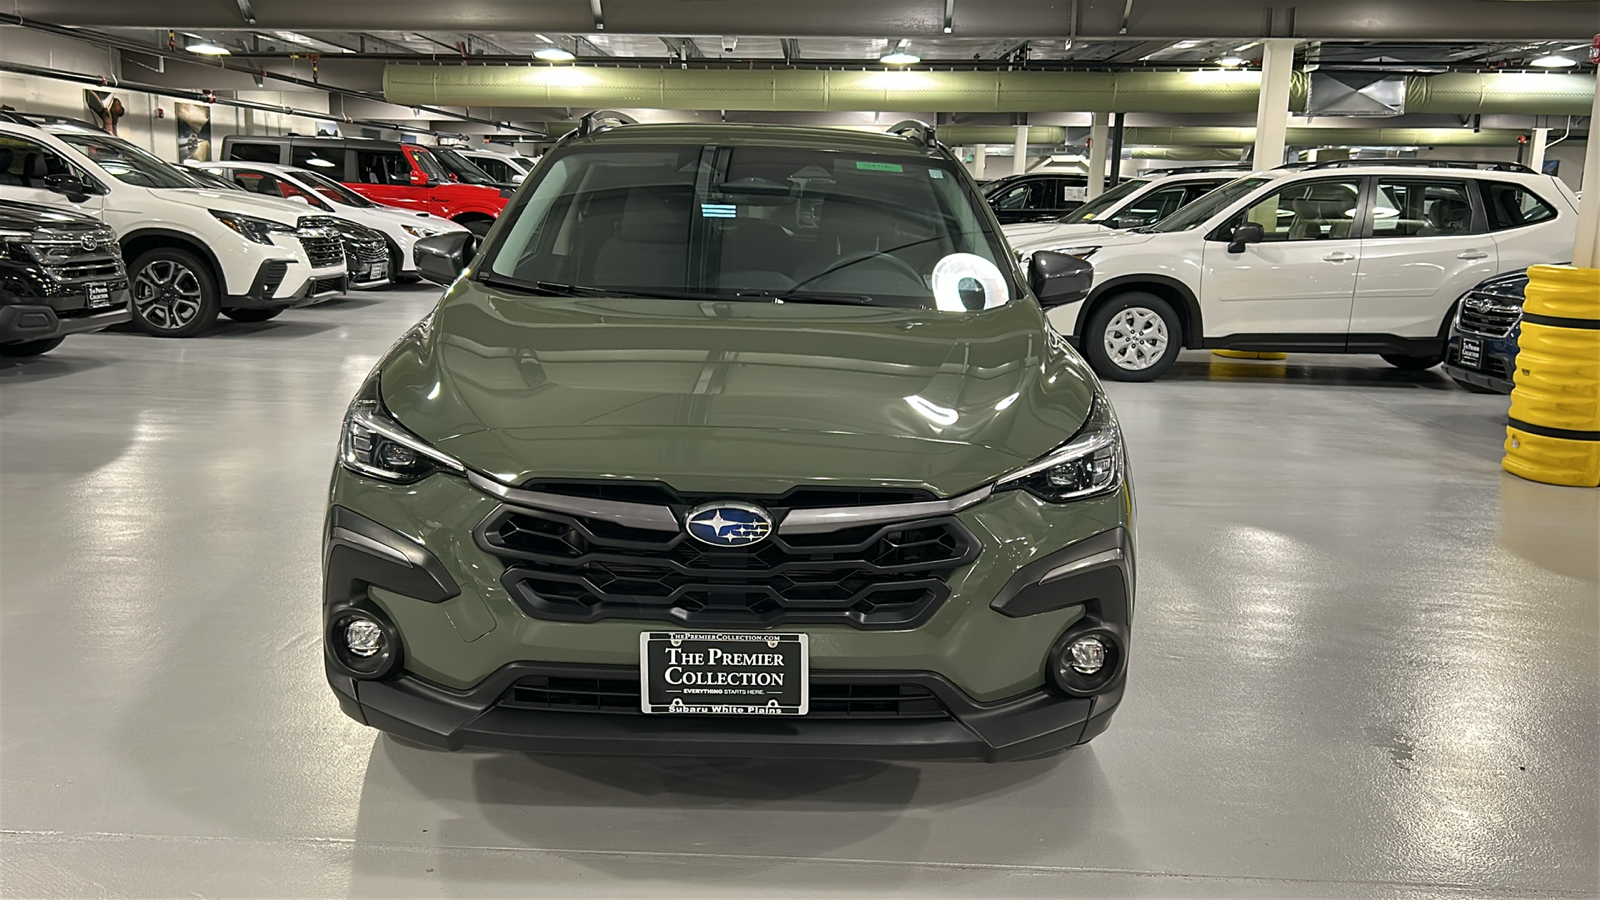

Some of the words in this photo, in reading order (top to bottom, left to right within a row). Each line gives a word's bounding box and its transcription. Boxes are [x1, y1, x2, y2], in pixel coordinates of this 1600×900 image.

[665, 647, 705, 665] THE
[707, 648, 785, 666] PREMIER
[664, 666, 785, 686] COLLECTION
[668, 705, 709, 714] Subaru
[711, 706, 745, 714] White
[749, 707, 783, 715] Plains
